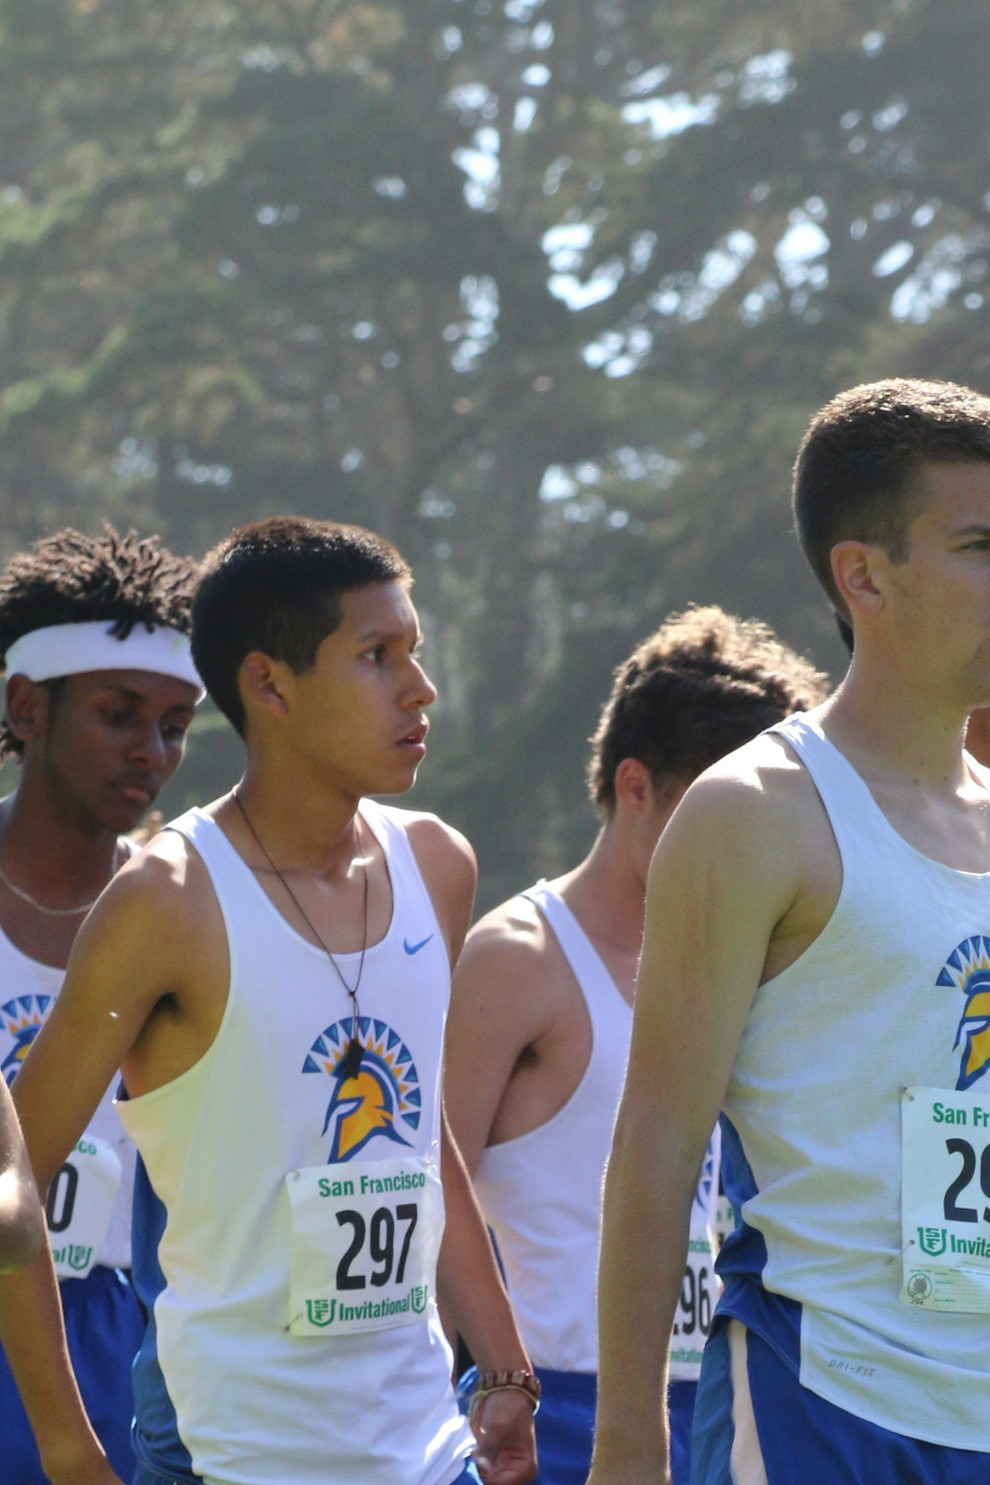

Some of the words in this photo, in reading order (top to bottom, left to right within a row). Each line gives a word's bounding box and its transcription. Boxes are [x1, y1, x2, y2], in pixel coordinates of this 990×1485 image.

[933, 1102, 967, 1126] San
[318, 1178, 355, 1198] San
[360, 1171, 426, 1195] Francisco
[335, 1203, 418, 1291] 297
[339, 1294, 411, 1321] Invitational
[673, 1264, 711, 1336] 96
